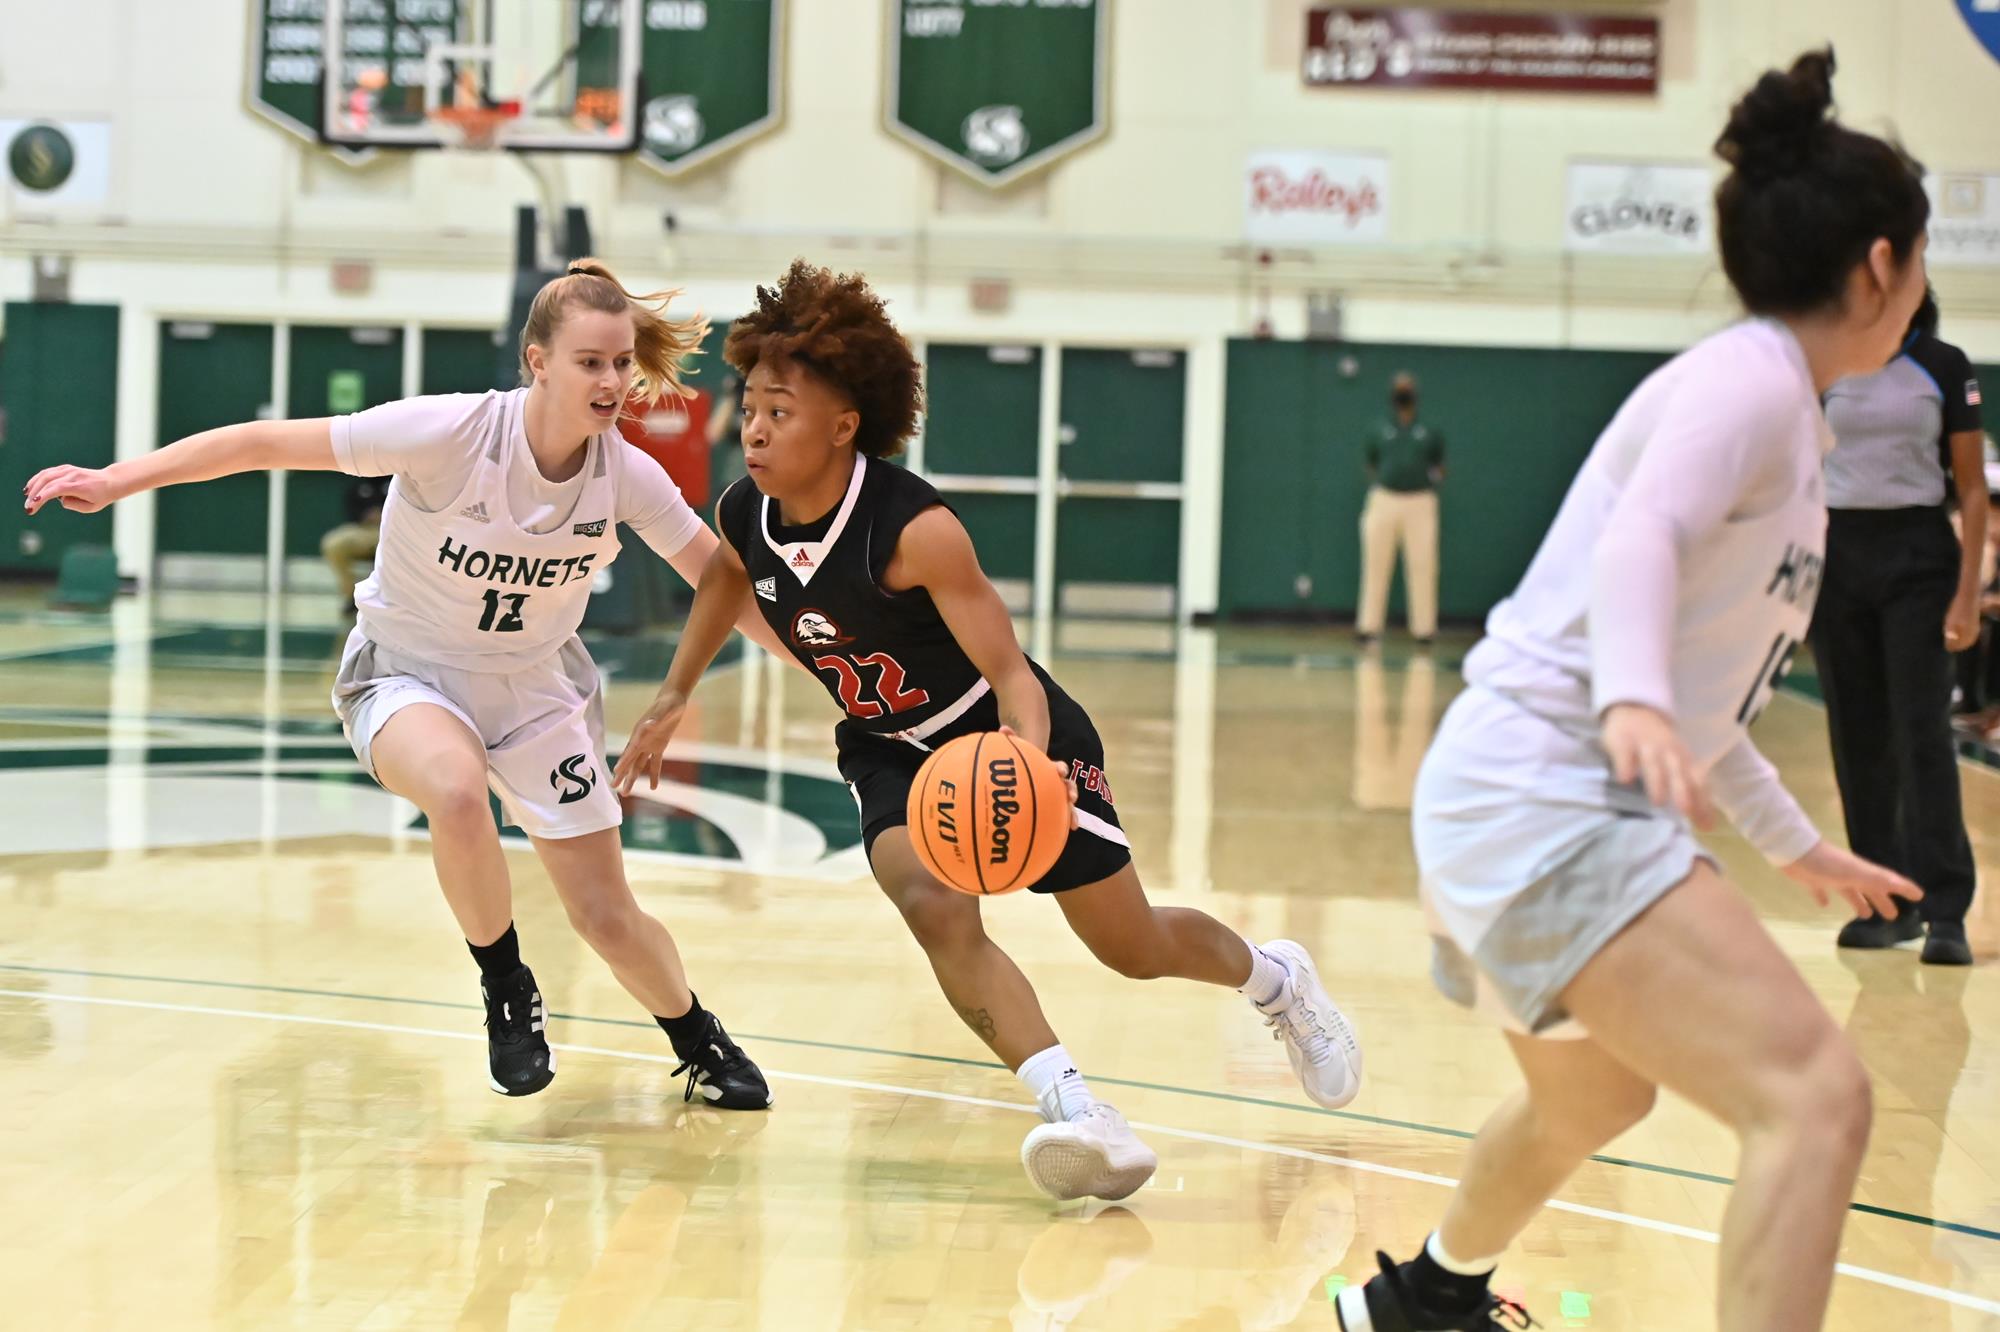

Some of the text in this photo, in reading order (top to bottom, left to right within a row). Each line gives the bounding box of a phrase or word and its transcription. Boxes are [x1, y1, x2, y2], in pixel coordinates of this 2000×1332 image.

[438, 537, 597, 588] HORNETS
[478, 589, 531, 632] 12
[812, 652, 930, 719] 22
[937, 780, 959, 844] EVO
[989, 758, 1020, 865] Wilson
